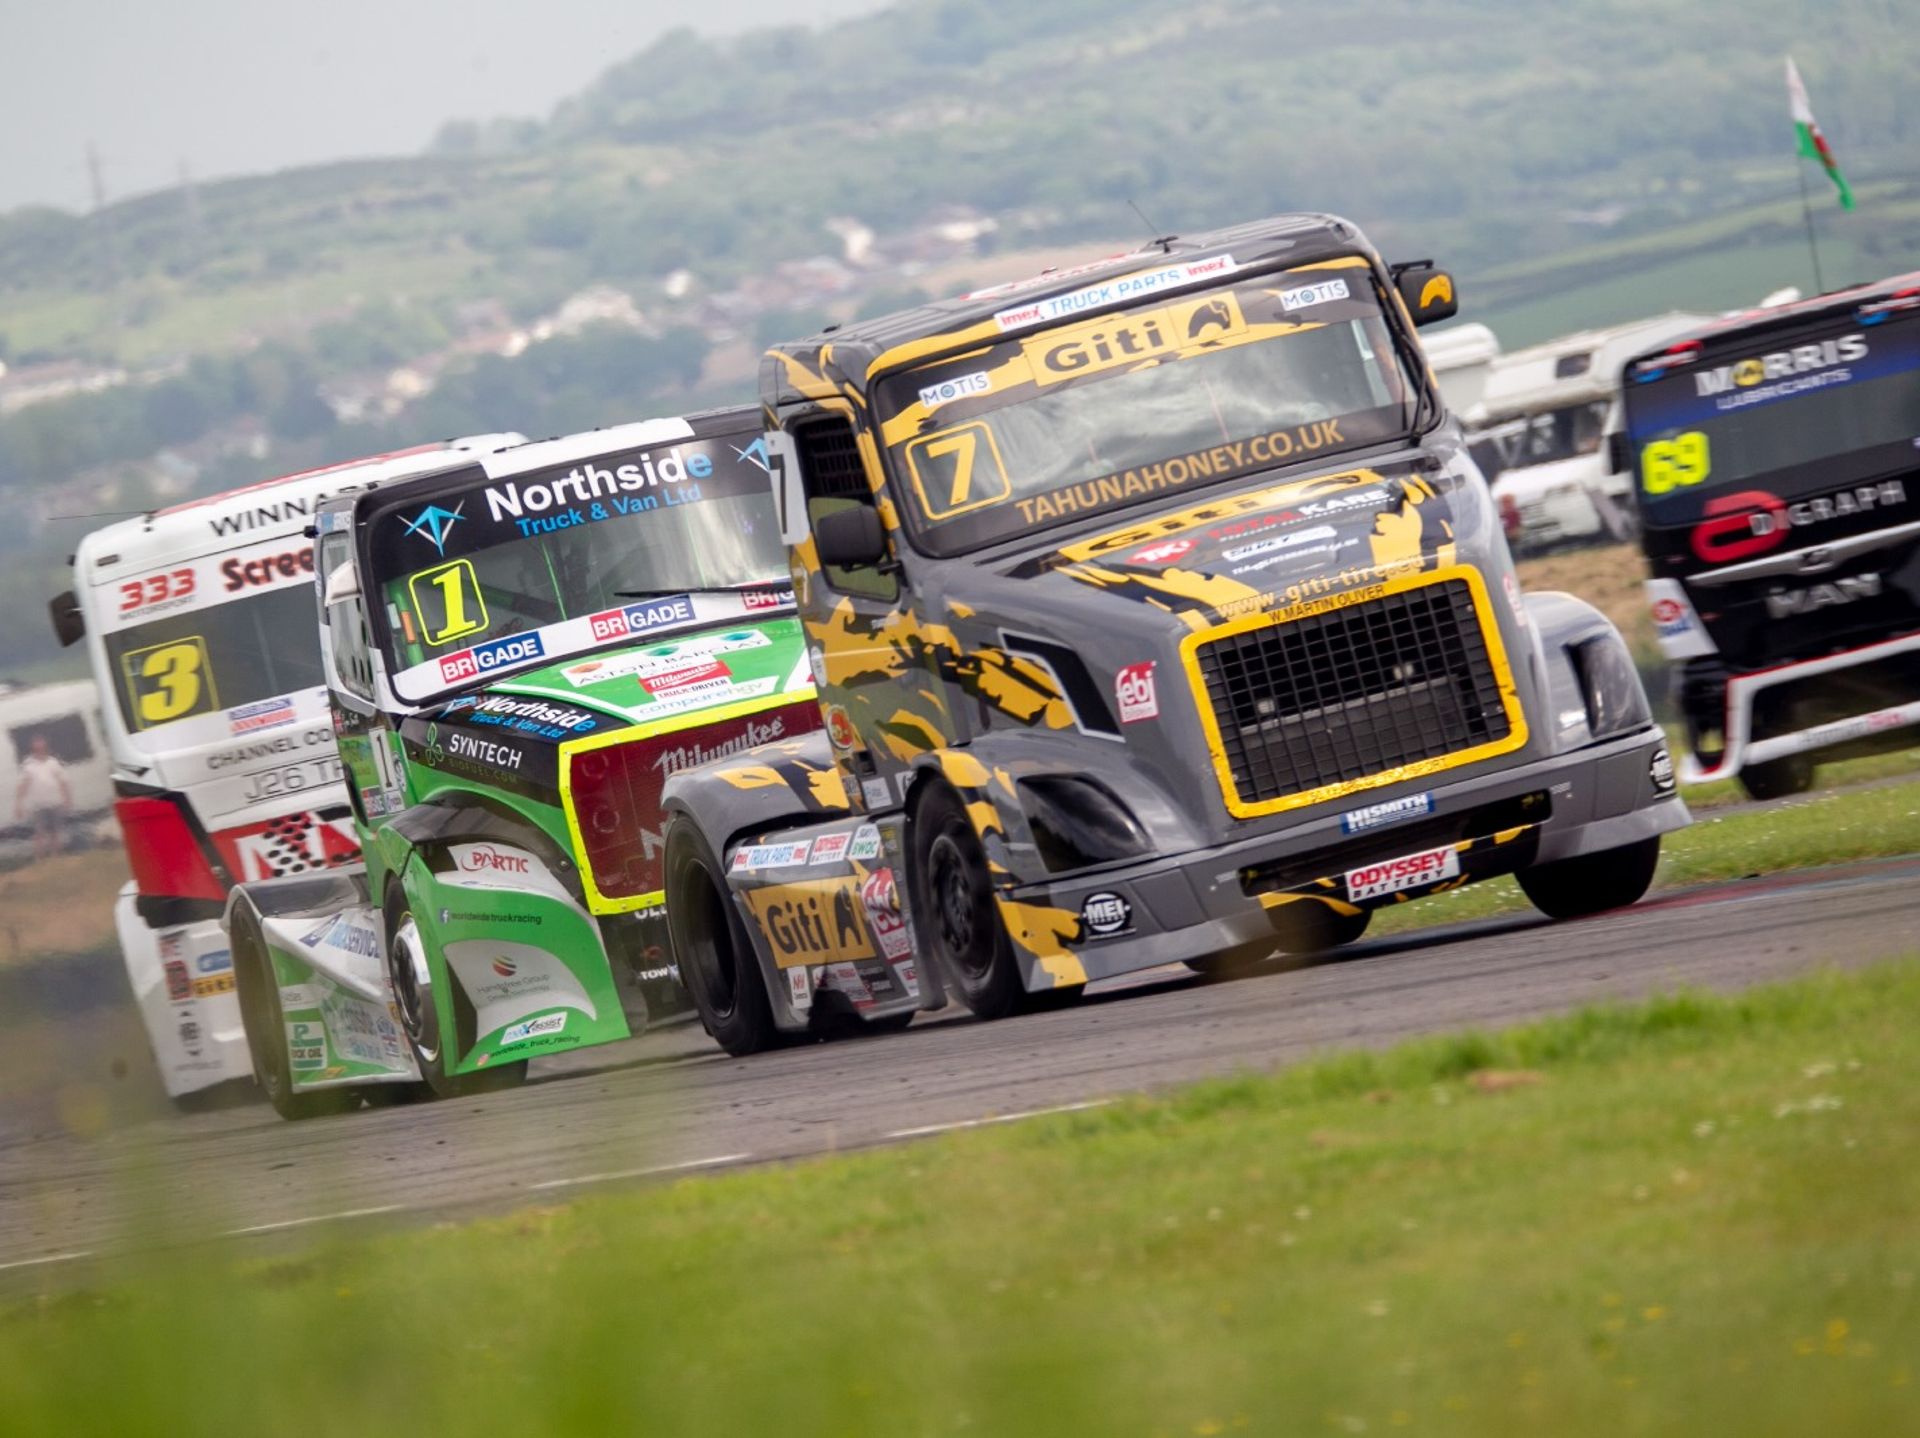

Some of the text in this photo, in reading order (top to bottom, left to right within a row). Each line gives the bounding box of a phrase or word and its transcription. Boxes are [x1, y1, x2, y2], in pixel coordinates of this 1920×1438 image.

[1049, 287, 1113, 316] TRUCK
[1118, 269, 1181, 297] PARTS
[1283, 281, 1347, 307] MOTIS
[1044, 321, 1164, 372] Giti
[1695, 334, 1868, 396] MORRIS
[922, 374, 988, 405] MOTIS
[925, 432, 976, 506] 7
[1015, 419, 1345, 524] TAHUNAHONEY.CO.UK
[1641, 432, 1710, 494] 69
[485, 449, 713, 522] Northside
[768, 454, 788, 534] 7
[515, 484, 702, 537] Truck & Van Ltd
[1089, 500, 1259, 551] Giti
[119, 568, 196, 611] 333
[432, 566, 477, 639] 1
[1337, 584, 1386, 609] OLIVER
[593, 602, 690, 638] BRIGADE
[442, 638, 539, 680] BRIGADE
[579, 661, 656, 684] ASTON
[648, 663, 720, 688] Milwaukee
[140, 644, 203, 721] 3
[470, 711, 501, 725] Truck
[516, 718, 540, 733] Van
[540, 725, 567, 739] Ltd
[474, 696, 597, 731] Northside
[206, 737, 300, 770] CHANNEL
[449, 733, 522, 769] SYNTECH
[651, 715, 785, 780] Milwaukee
[244, 767, 305, 799] J26
[1346, 793, 1428, 821] HISMITH
[1350, 850, 1447, 888] ODYSSEY
[1353, 869, 1444, 898] BATTERY
[767, 897, 829, 954] Giti
